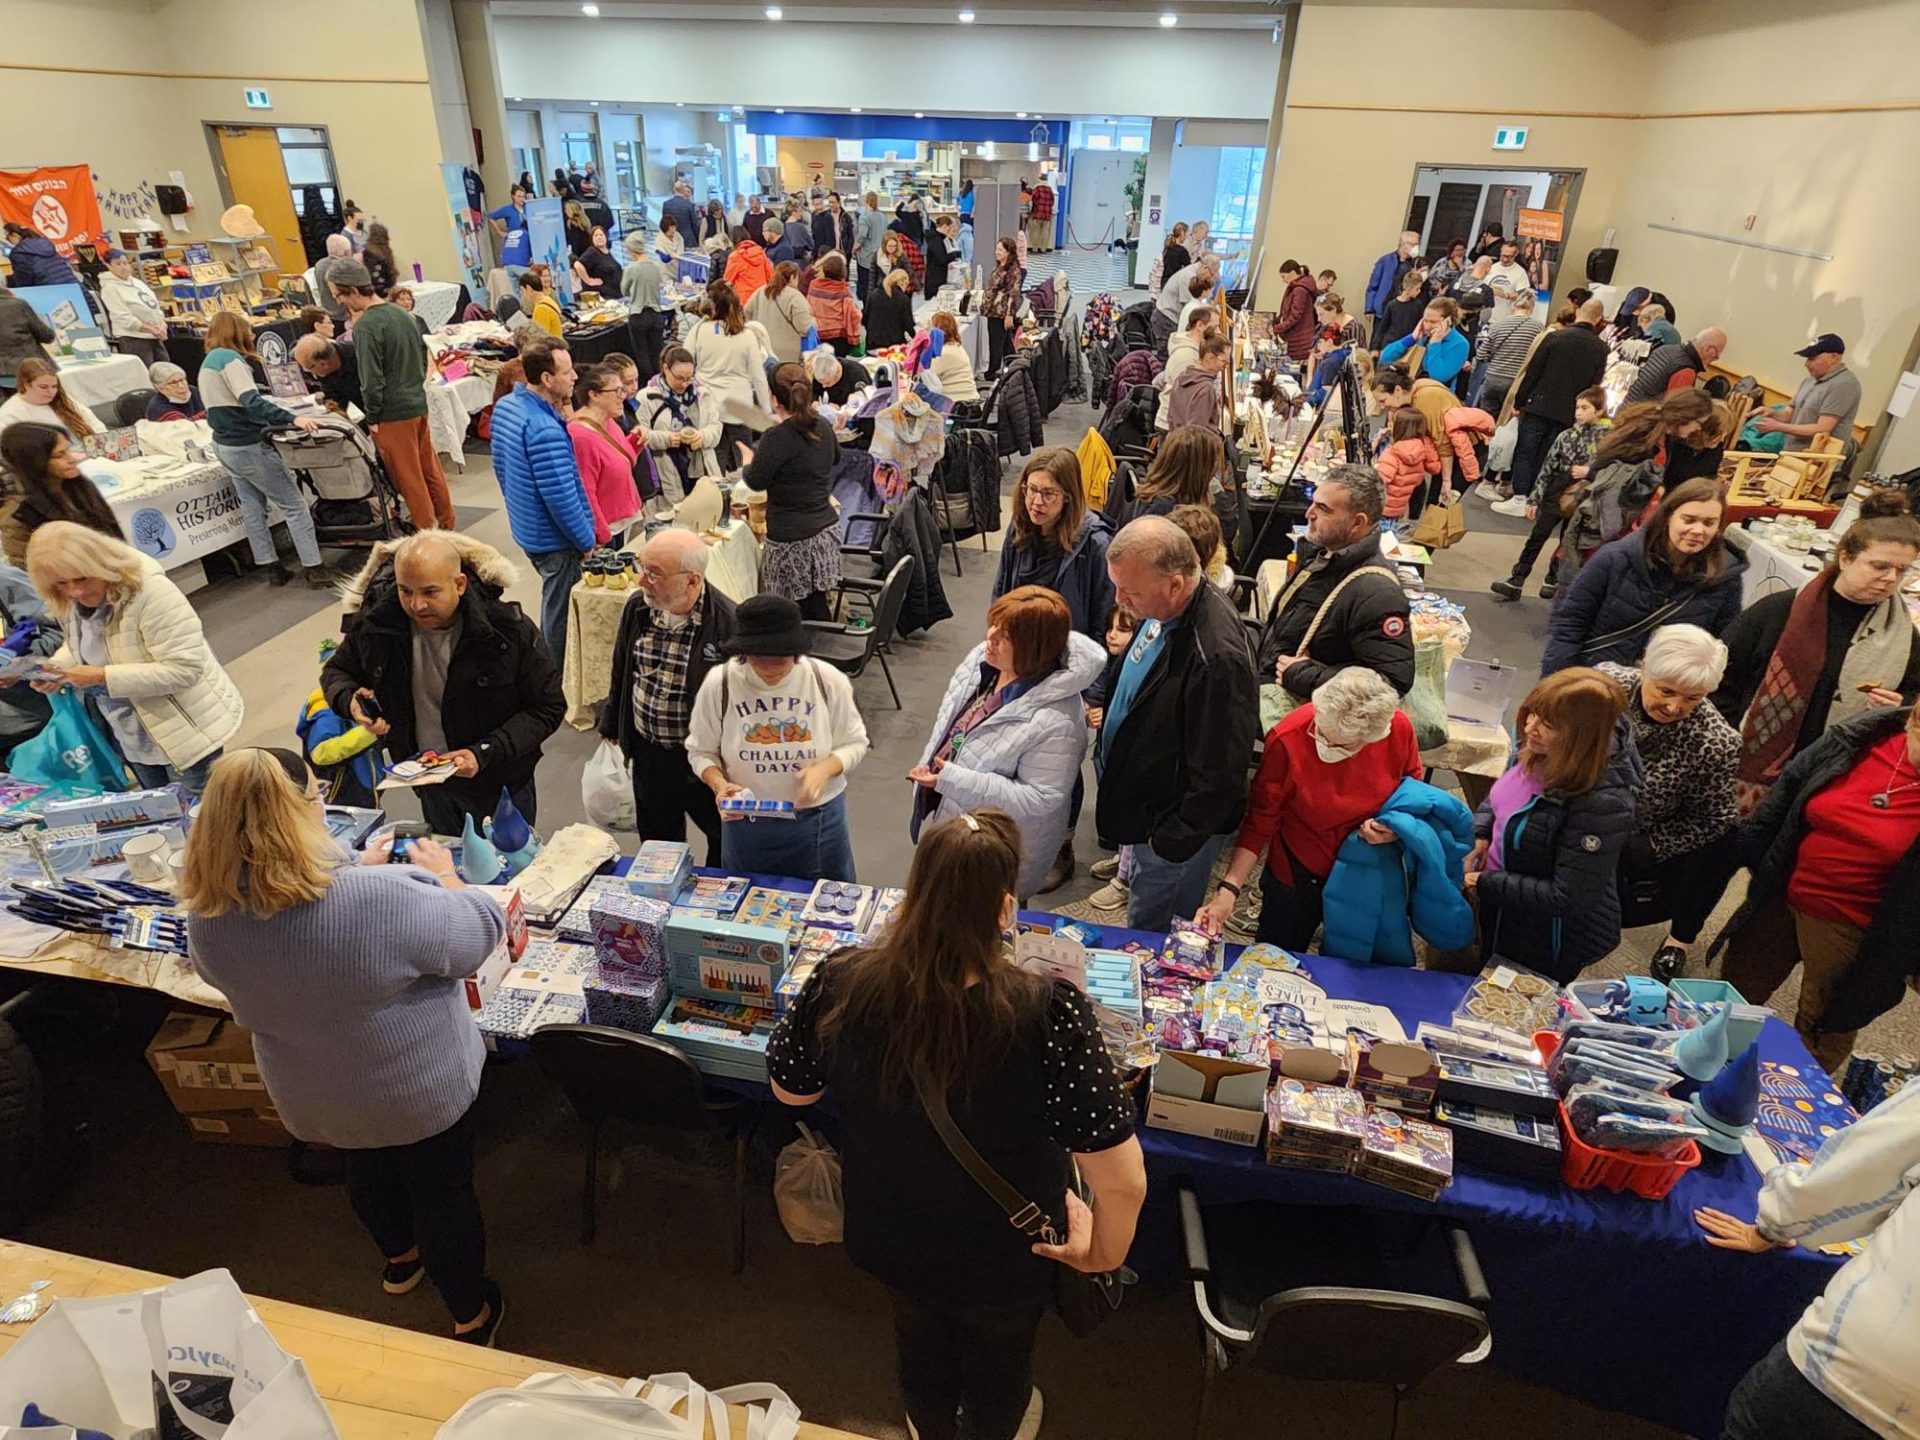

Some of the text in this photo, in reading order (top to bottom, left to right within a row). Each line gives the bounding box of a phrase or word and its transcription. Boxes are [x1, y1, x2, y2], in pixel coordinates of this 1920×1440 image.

[96, 191, 157, 219] HANUKKAH
[109, 184, 148, 206] HAPPY
[175, 487, 238, 514] OTTAW
[735, 697, 815, 718] HAPPY
[739, 749, 817, 761] CHALLAH
[755, 762, 802, 774] DAYS
[1265, 984, 1317, 1007] LATKES
